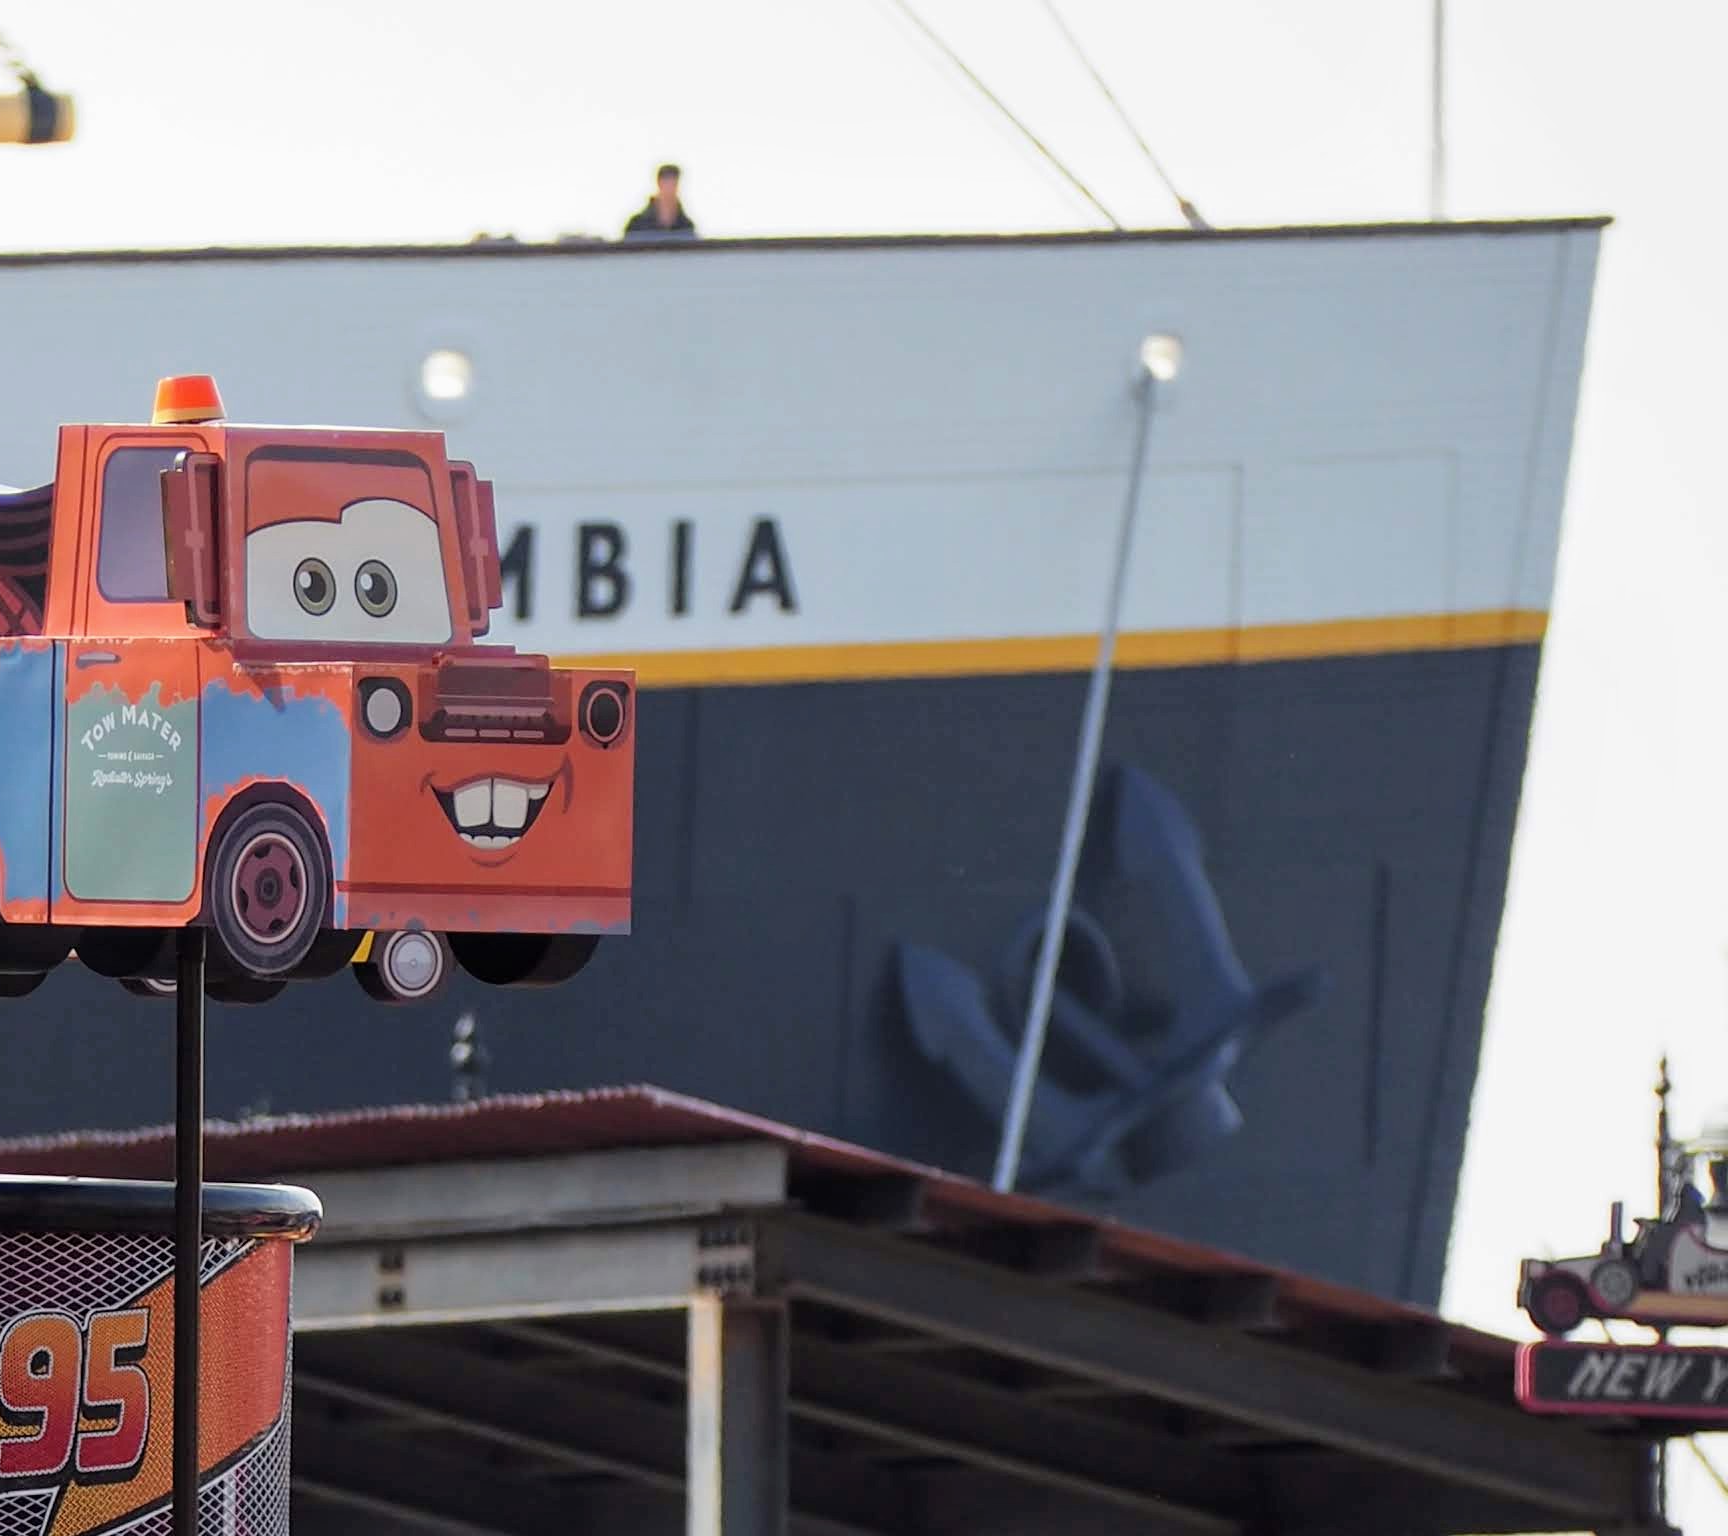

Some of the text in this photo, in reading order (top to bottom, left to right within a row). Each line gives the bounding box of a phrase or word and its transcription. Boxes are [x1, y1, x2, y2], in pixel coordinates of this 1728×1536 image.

[81, 704, 182, 752] TOW MATER
[1568, 1353, 1694, 1397] NEW
